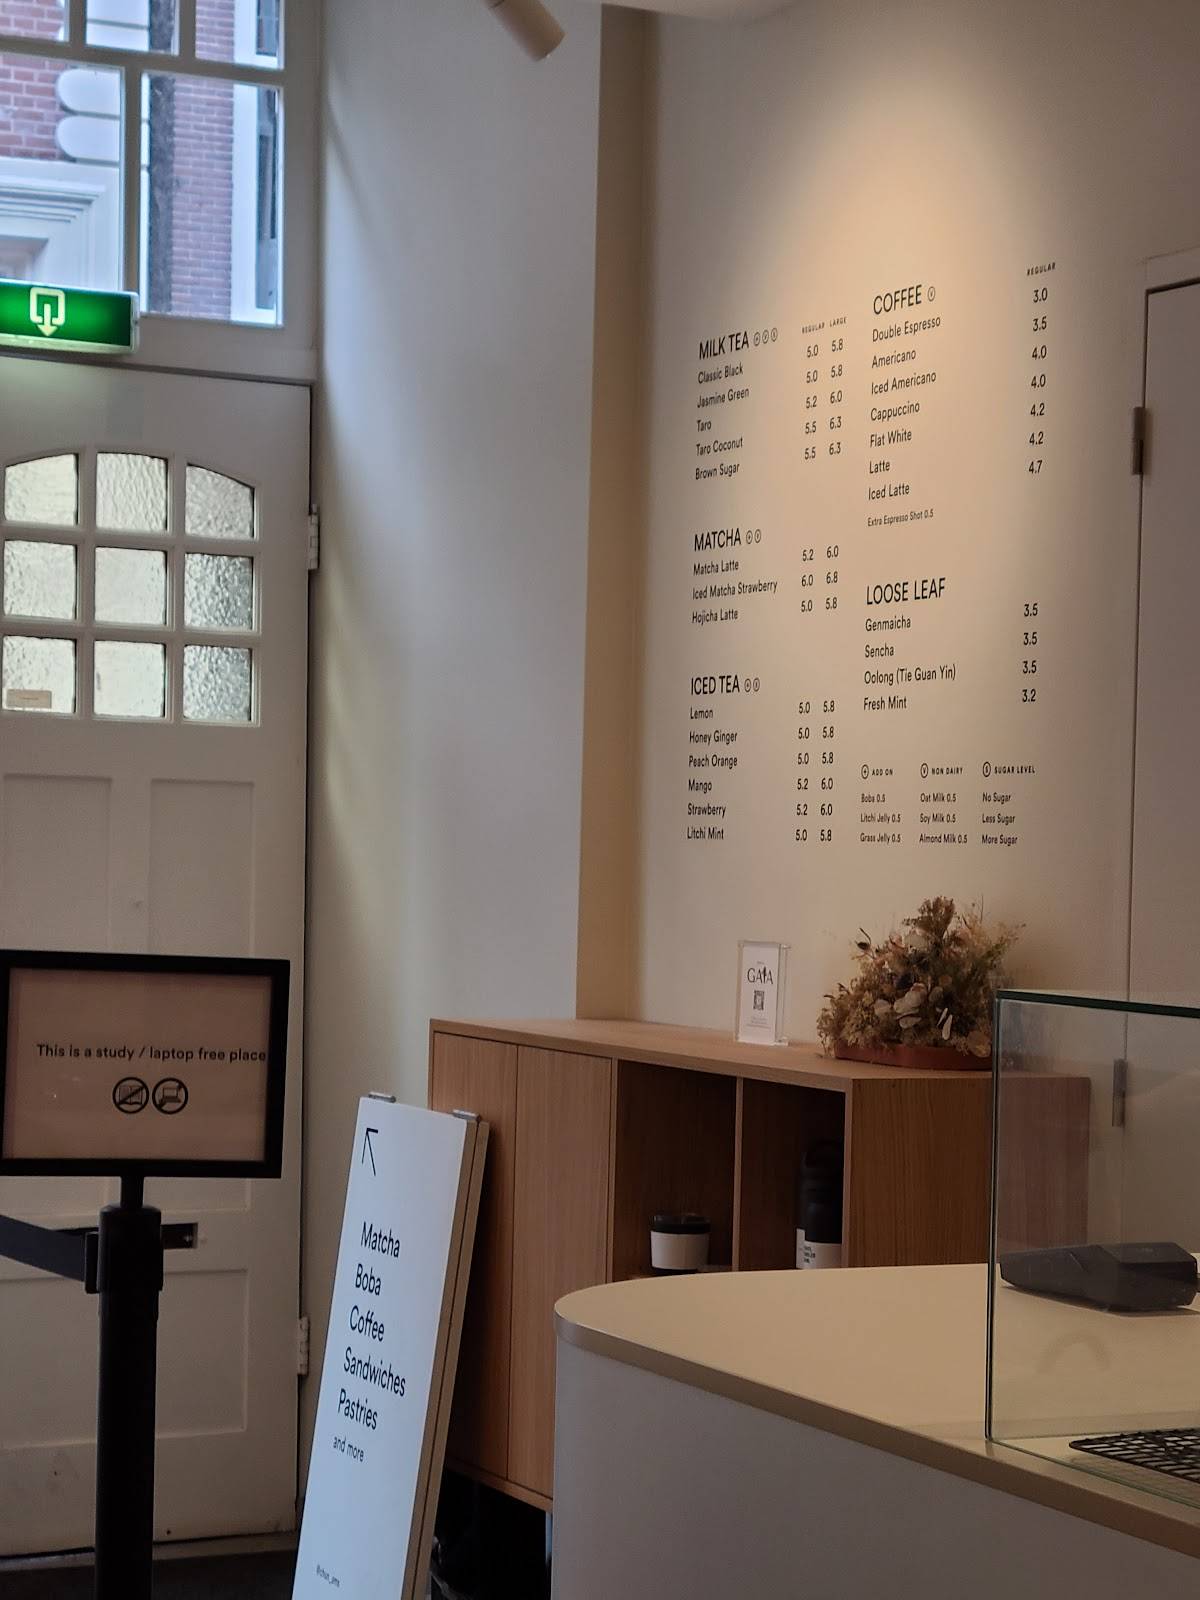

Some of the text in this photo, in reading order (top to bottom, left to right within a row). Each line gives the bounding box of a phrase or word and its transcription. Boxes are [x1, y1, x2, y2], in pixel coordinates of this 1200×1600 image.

[873, 284, 923, 315] COFFEE
[1033, 288, 1048, 303] 3.0
[872, 316, 941, 342] Double Espresso
[1032, 316, 1047, 332] 3.5
[699, 331, 750, 360] MILK TEA
[807, 338, 843, 358] 5.0 5.8
[1032, 345, 1046, 360] 4.0
[871, 349, 916, 368] Americano
[698, 363, 743, 384] Classic Black
[806, 364, 843, 383] 5.0 5.8
[1031, 374, 1046, 389] 4.0
[871, 372, 937, 394] Iced Americano
[697, 387, 749, 408] Jasmine Green
[806, 390, 842, 409] 5.2 6.0
[871, 401, 920, 422] Cappuccino
[1030, 402, 1045, 417] 4.2
[697, 419, 712, 432] Taro
[805, 416, 841, 434] 5.5 6.3
[870, 428, 912, 448] Flat White
[1029, 431, 1044, 446] 4.2
[696, 437, 743, 456] Taro Coconut
[804, 442, 841, 460] 5.5 6.3
[696, 463, 740, 480] Brown Sugar
[869, 460, 890, 474] Latte
[1029, 460, 1042, 474] 4.7
[868, 482, 910, 500] Iced Latte
[694, 528, 741, 552] MATCHA
[802, 545, 839, 561] 5.2 6.0
[693, 560, 739, 576] Matcha Latte
[801, 571, 838, 587] 6.0 6.8
[693, 579, 777, 600] Iced Matcha Strawberry
[866, 577, 945, 605] LOOSE LEAF
[801, 597, 837, 612] 5.0 5.8
[1024, 603, 1038, 617] 3.5
[692, 608, 738, 626] Hojicha Latte
[865, 616, 911, 632] Genmaicha
[1023, 632, 1037, 646] 3.5
[865, 643, 894, 658] Sencha
[864, 664, 956, 686] Oolong (Tie Guan Yin)
[1023, 660, 1037, 674] 3.5
[691, 675, 740, 695] ICED TEA
[863, 696, 907, 710] Fresh Mint
[1022, 689, 1036, 702] 3.2
[690, 707, 713, 719] Lemon
[799, 700, 835, 713] 5.0 5.8
[689, 730, 737, 746] Honey Ginger
[798, 726, 834, 739] 5.0 5.8
[689, 755, 737, 769] Peach Orange
[798, 752, 833, 764] 5.0 5.8
[688, 779, 712, 794] Mango
[797, 778, 833, 790] 5.2 6.0
[982, 792, 1011, 804] No Sugar
[688, 803, 726, 818] Strawberry
[797, 804, 832, 815] 5.2 6.0
[982, 813, 1015, 825] Less Sugar
[687, 827, 724, 840] Litchi Mint
[796, 829, 832, 841] 5.0 5.8
[982, 834, 1018, 846] More Sugar
[37, 1044, 65, 1057] This
[69, 1045, 80, 1057] is
[84, 1048, 92, 1058] a
[96, 1045, 134, 1062] study
[150, 1046, 194, 1063] laptop
[198, 1046, 225, 1060] free
[229, 1048, 266, 1063] place
[360, 1221, 400, 1258] Matcha
[355, 1263, 381, 1296] Boba
[350, 1305, 384, 1342] Coffee
[343, 1346, 406, 1397] Sandwiches
[337, 1388, 377, 1430] Pastries
[333, 1436, 364, 1463] and more
